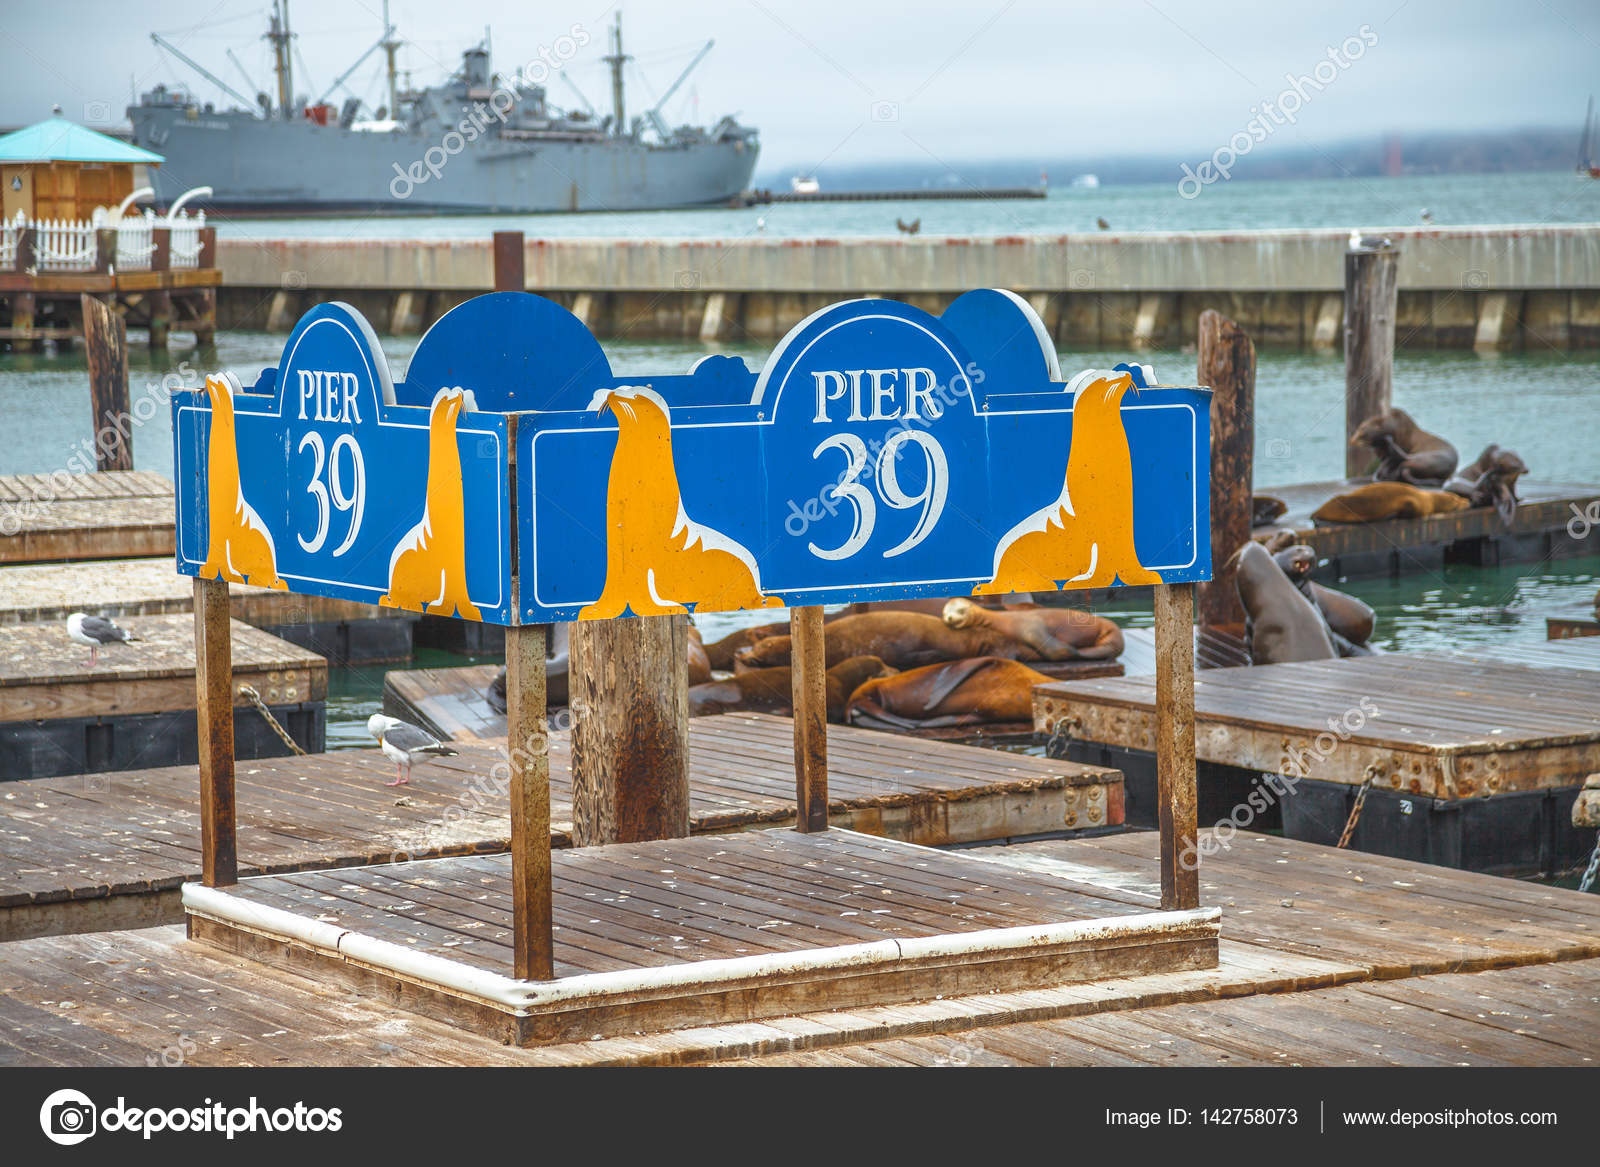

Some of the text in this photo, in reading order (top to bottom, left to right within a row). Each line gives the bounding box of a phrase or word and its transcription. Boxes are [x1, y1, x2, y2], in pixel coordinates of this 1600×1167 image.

[297, 370, 362, 424] PIER
[811, 368, 944, 423] PIER
[297, 431, 366, 557] 39
[808, 430, 949, 560] 39
